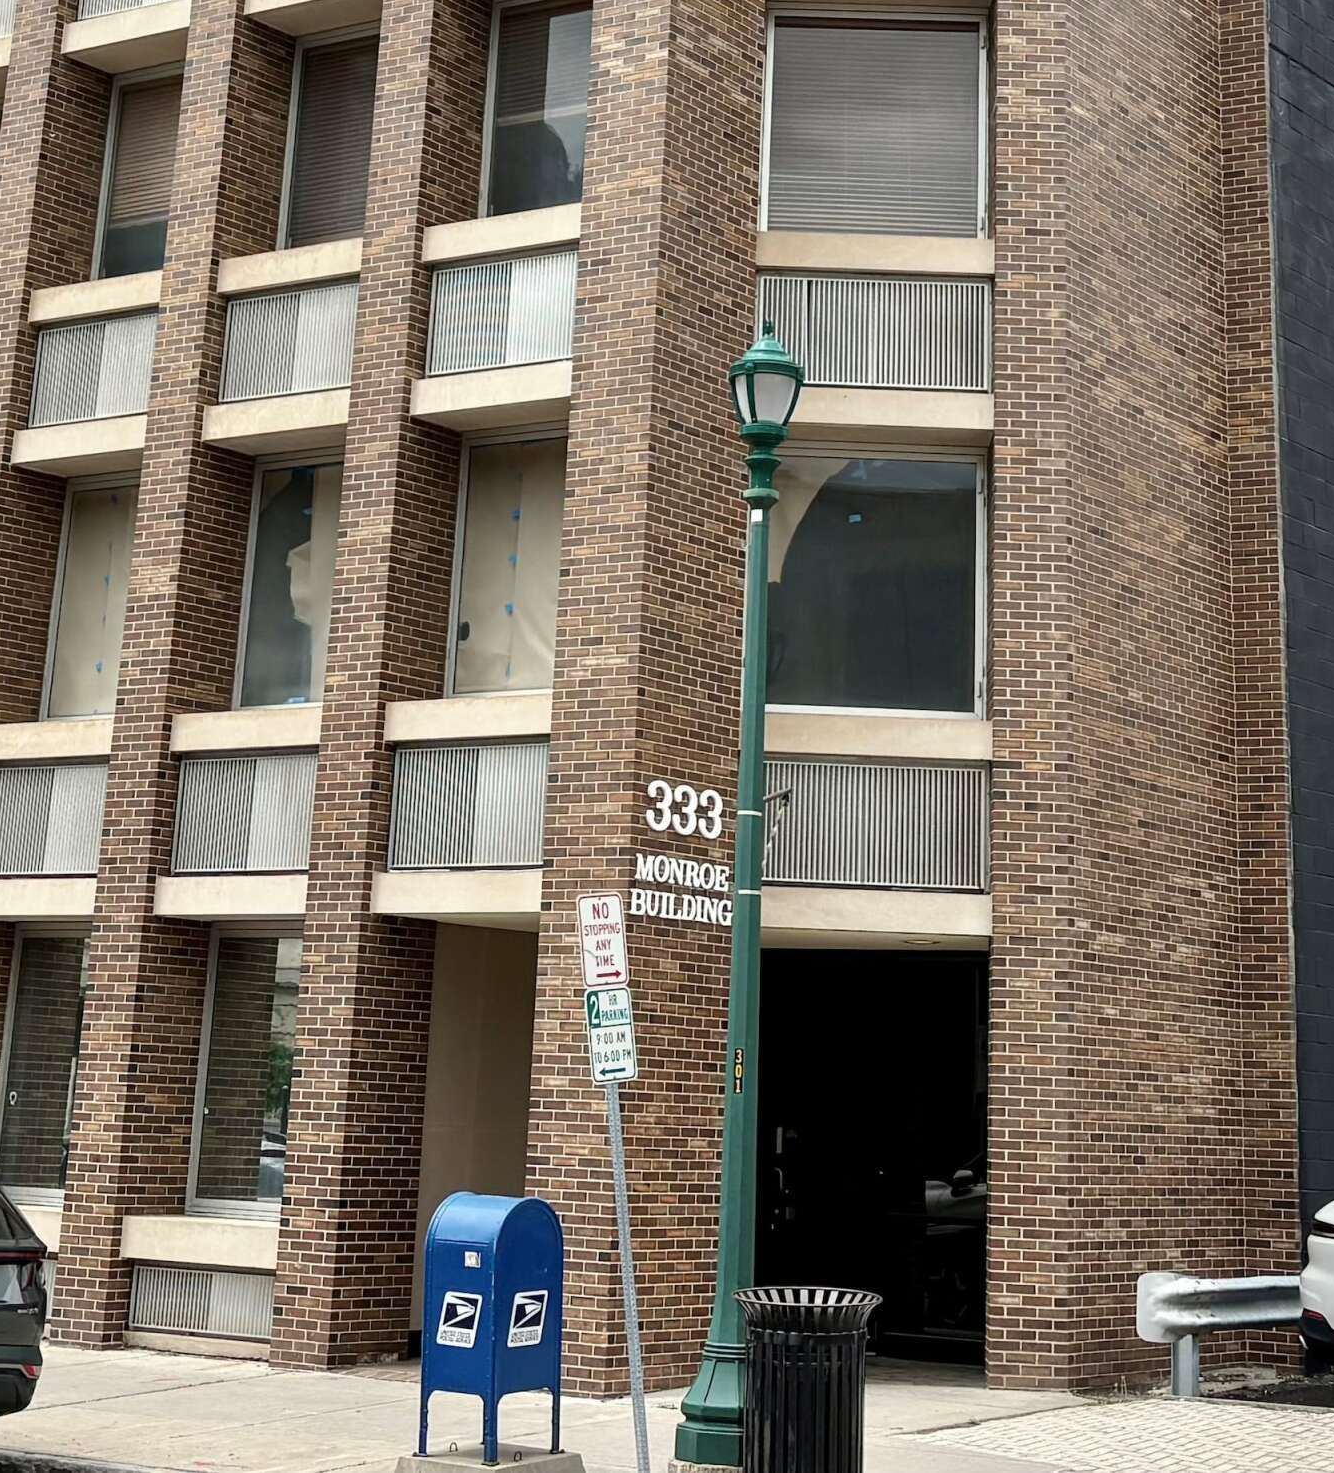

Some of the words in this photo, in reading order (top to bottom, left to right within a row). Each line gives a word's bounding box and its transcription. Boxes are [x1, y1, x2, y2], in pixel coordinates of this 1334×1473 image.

[645, 779, 724, 840] 333
[634, 852, 730, 893] MONROE
[592, 902, 610, 920] NO
[629, 888, 734, 927] BUILDING
[584, 922, 621, 936] STOPPING
[595, 939, 612, 951] ANY
[595, 954, 616, 968] TIME
[589, 994, 600, 1024] 2
[601, 1008, 629, 1022] PARKING
[616, 1030, 626, 1043] AM
[594, 1051, 602, 1064] TO
[622, 1048, 632, 1061] PM
[735, 1048, 743, 1093] 301
